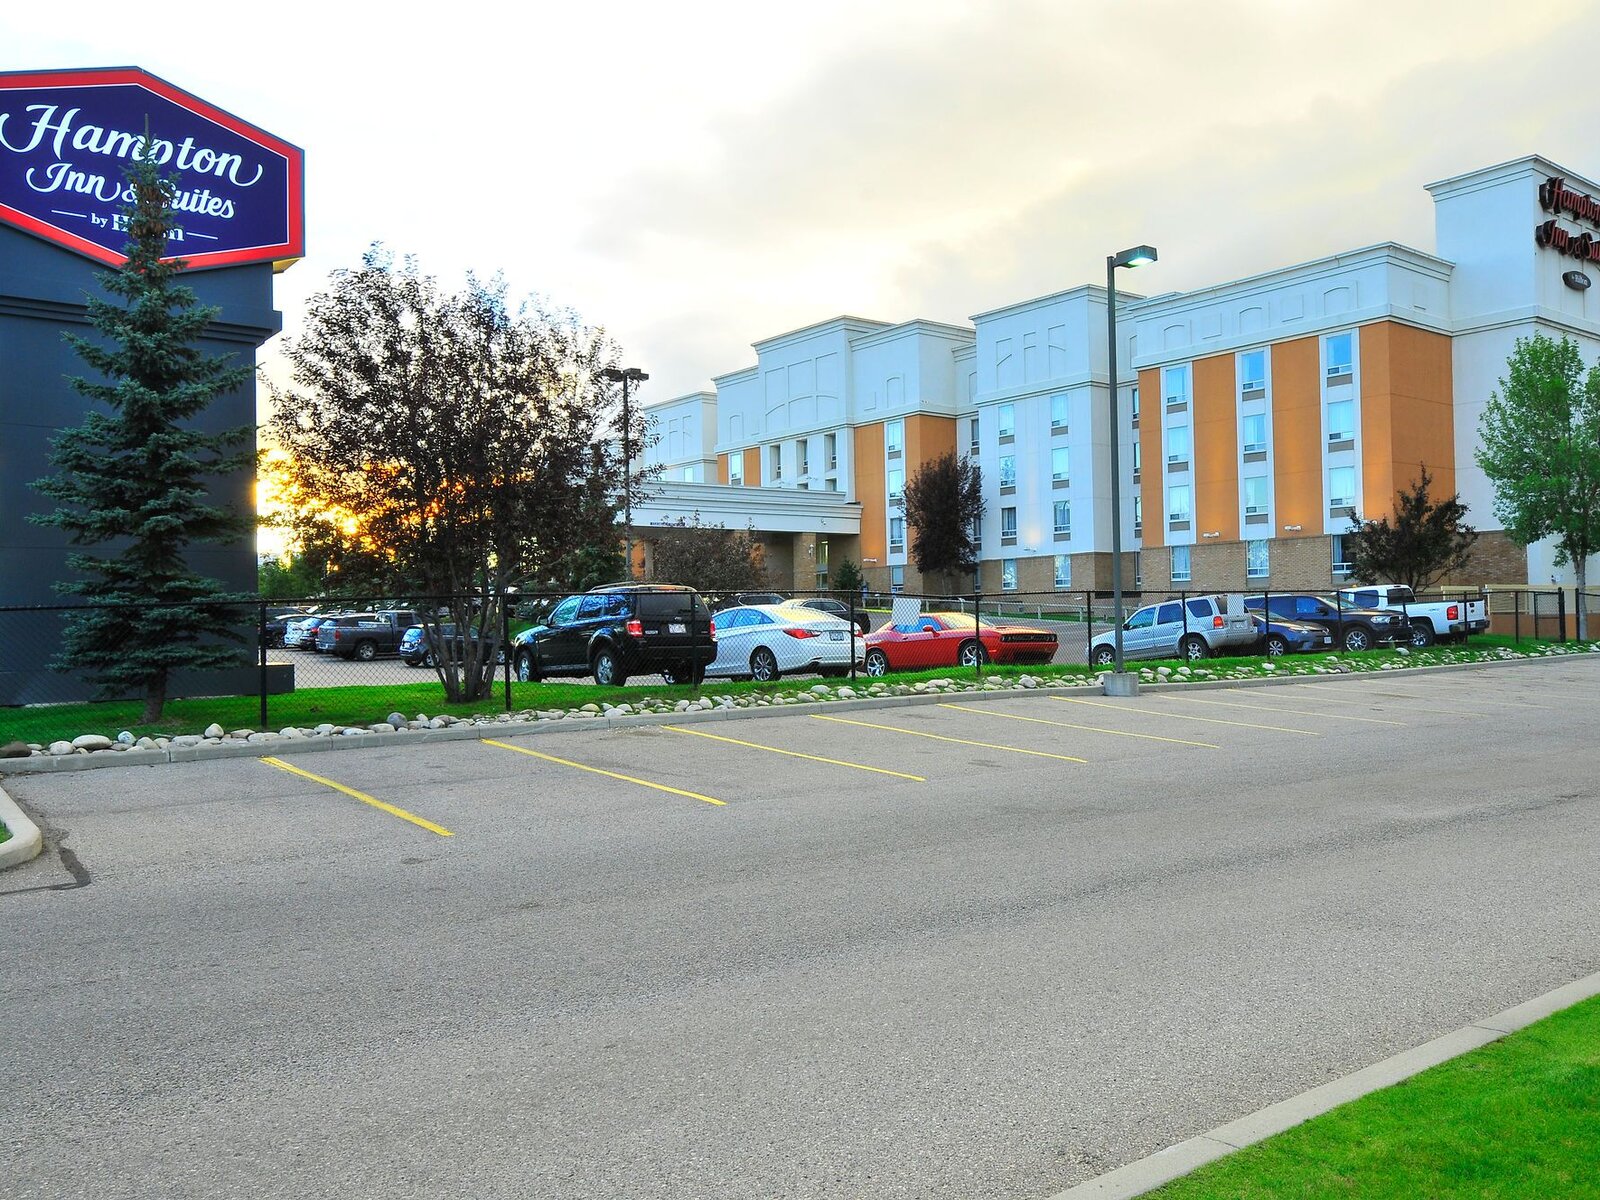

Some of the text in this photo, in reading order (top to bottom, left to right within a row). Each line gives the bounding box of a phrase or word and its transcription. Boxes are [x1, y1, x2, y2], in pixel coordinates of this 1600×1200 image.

[0, 104, 263, 187] Hampton
[26, 162, 121, 201] Inn
[91, 212, 108, 229] by
